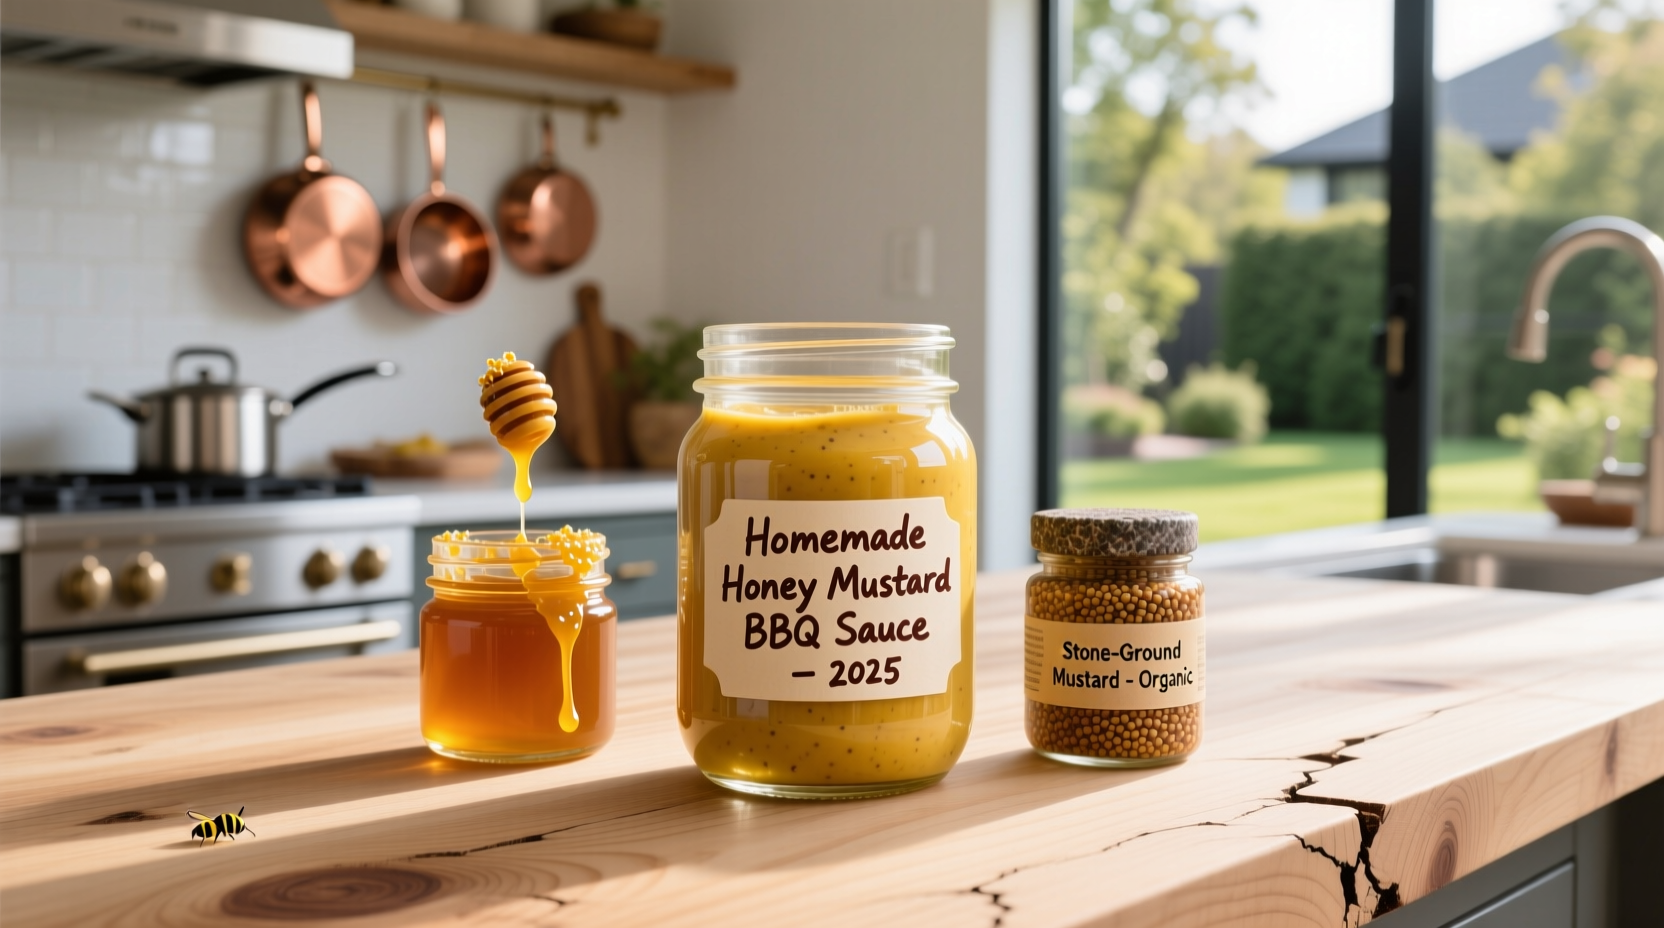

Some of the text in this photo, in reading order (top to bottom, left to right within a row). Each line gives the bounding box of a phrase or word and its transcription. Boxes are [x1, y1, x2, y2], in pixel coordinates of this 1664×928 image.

[744, 512, 927, 557] Homemade
[721, 556, 952, 614] Honey Mustard
[744, 610, 930, 650] BBQ Sauce
[1062, 639, 1181, 662] Stone-Ground
[828, 655, 902, 688] 2025
[1052, 666, 1120, 689] Mustard
[1138, 666, 1194, 693] Organic
